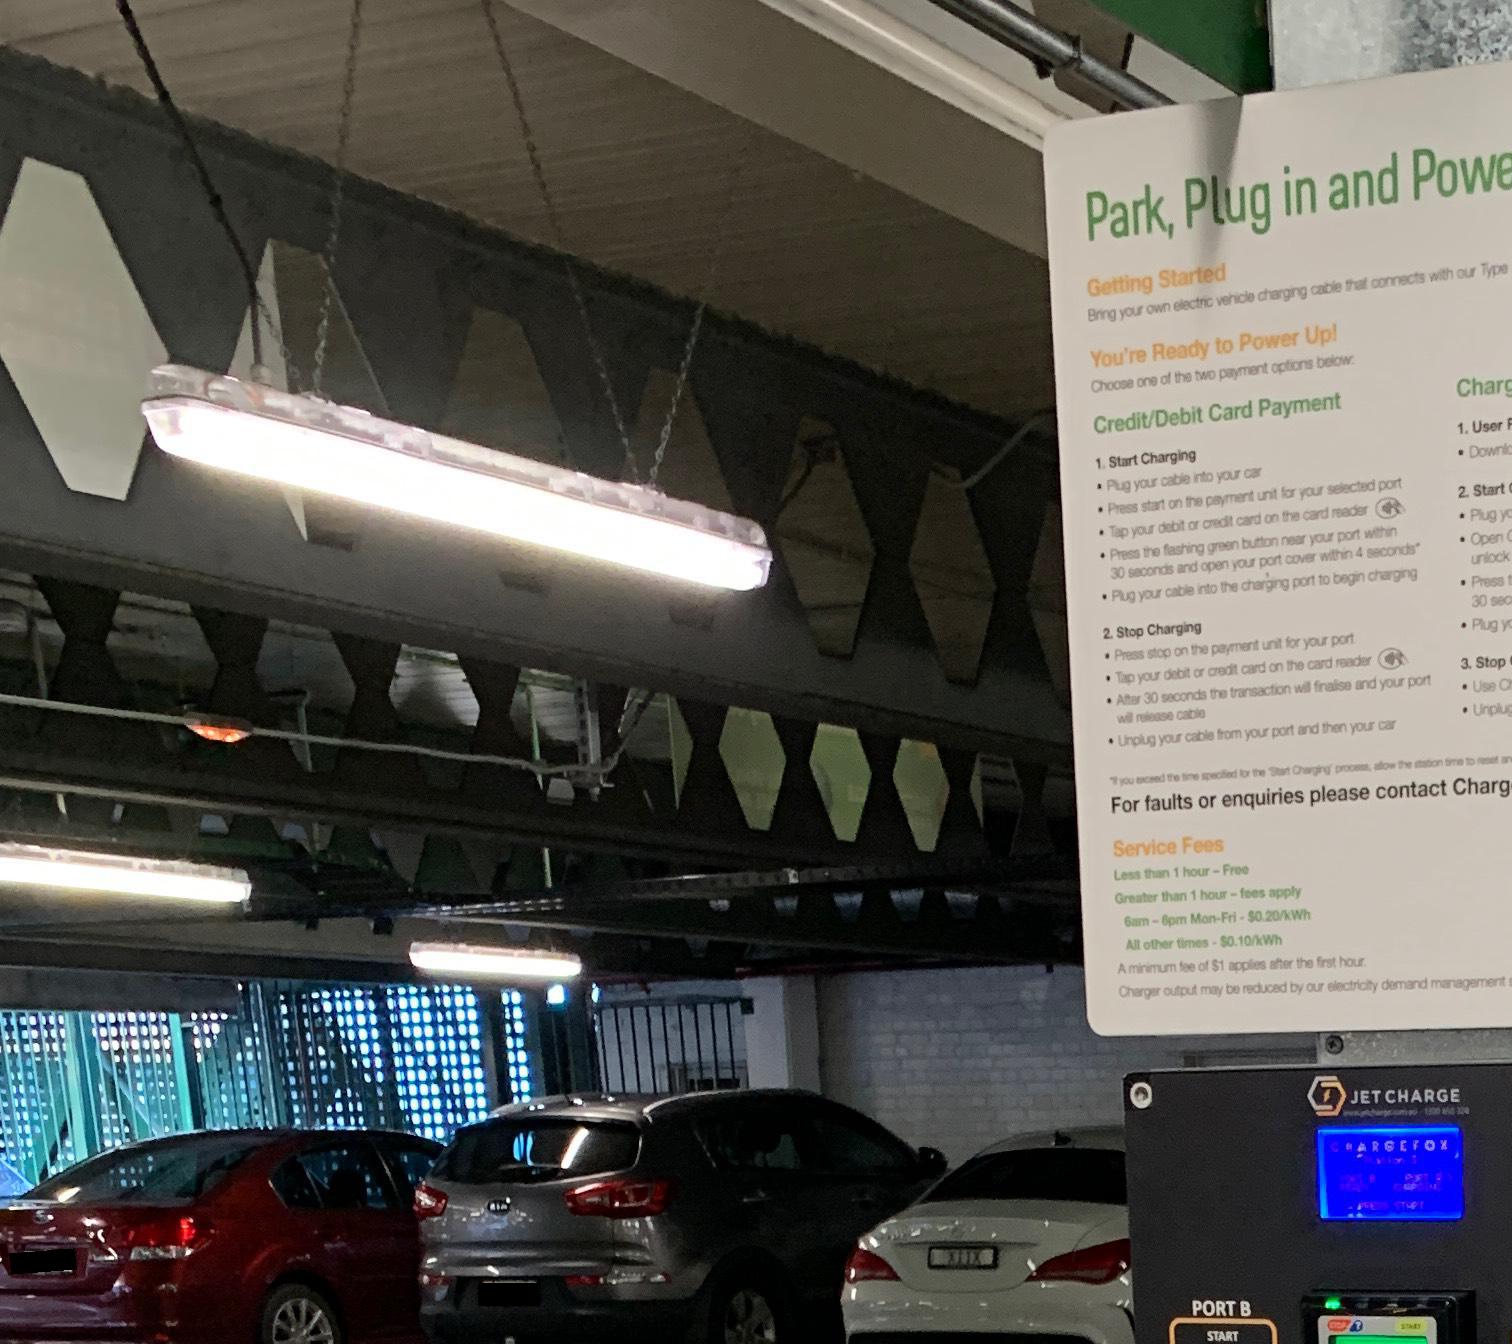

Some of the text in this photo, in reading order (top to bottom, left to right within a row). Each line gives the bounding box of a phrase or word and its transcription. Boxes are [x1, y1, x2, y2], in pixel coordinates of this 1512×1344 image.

[1086, 183, 1175, 242] Park,
[1184, 170, 1272, 243] Plug
[1283, 165, 1317, 217] in
[1328, 152, 1399, 211] and
[1087, 262, 1226, 301] Getting Started
[1087, 307, 1117, 323] Bring
[1118, 304, 1144, 322] your
[1145, 302, 1172, 316] own
[1172, 294, 1214, 312] electric
[1215, 290, 1256, 307] vehicle
[1256, 285, 1308, 303] charging
[1310, 280, 1343, 296] cable
[1344, 276, 1368, 292] that
[1370, 271, 1427, 289] connects
[1428, 267, 1454, 283] with
[1456, 266, 1477, 280] our
[1480, 263, 1509, 280] Type
[1089, 322, 1338, 369] You're Ready to Power Up!
[1093, 391, 1342, 435] Credit/Debit Card Payment
[1457, 421, 1469, 435] 1.
[1472, 419, 1504, 434] User
[1095, 448, 1196, 469] 1. Start Charging
[1458, 485, 1470, 499] 2.
[1472, 482, 1506, 498] Start
[1102, 621, 1202, 640] 2. Stop Charging
[1460, 657, 1472, 671] 3.
[1475, 655, 1507, 671] Stop
[1111, 796, 1141, 814] For
[1144, 792, 1194, 812] faults
[1198, 794, 1217, 809] or
[1220, 787, 1305, 811] enquiries
[1309, 784, 1370, 808] please
[1375, 779, 1448, 800] contact
[1112, 835, 1225, 858] Service Fees
[1113, 863, 1250, 882] Less than 1 hour Free
[1191, 1300, 1252, 1318] PORT B
[1207, 1330, 1239, 1342] START
